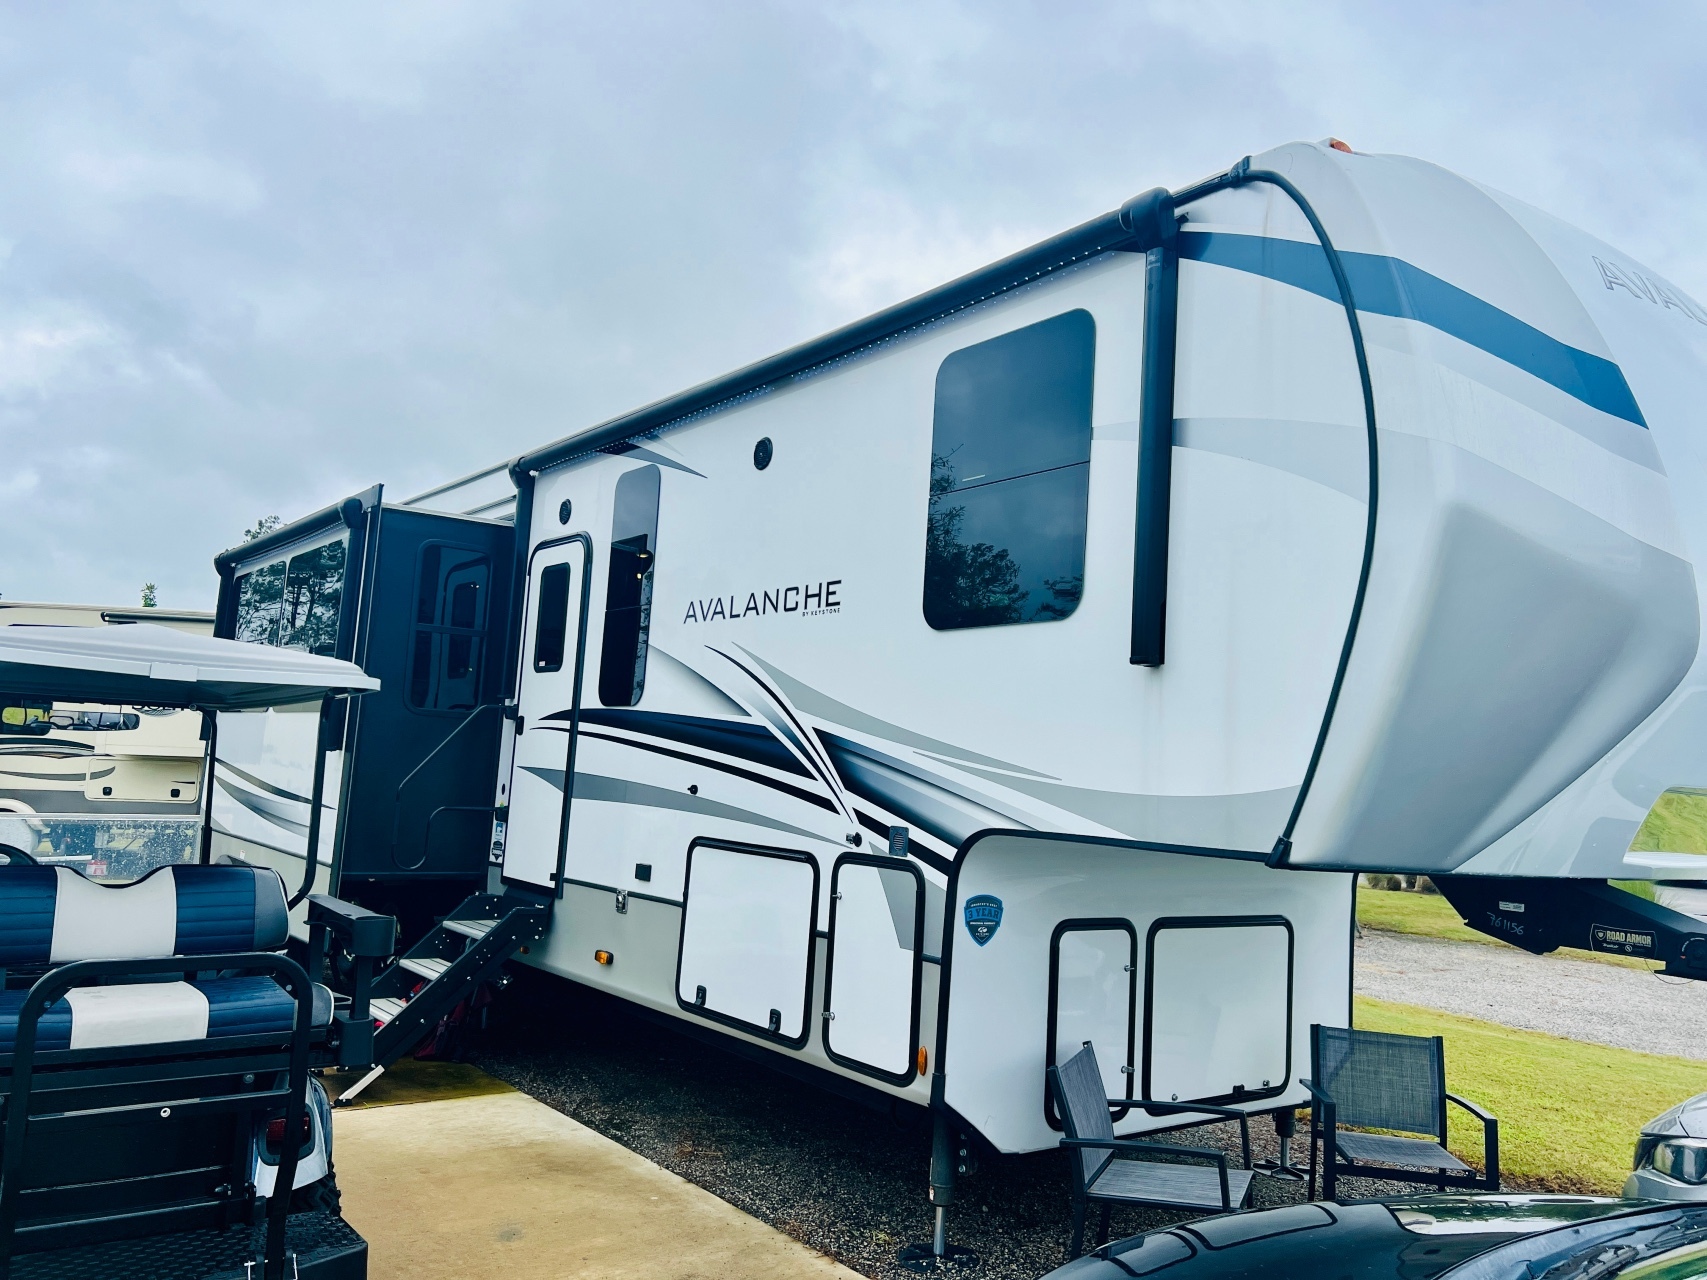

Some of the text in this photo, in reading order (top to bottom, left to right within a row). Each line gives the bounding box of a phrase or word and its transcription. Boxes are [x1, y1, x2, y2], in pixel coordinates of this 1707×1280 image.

[683, 579, 842, 625] AVALANCHE
[802, 607, 841, 618] BY KEYSTONE
[967, 907, 1000, 920] 3 YEAR
[1486, 911, 1525, 936] 761156
[1606, 930, 1626, 942] ROAD
[1626, 933, 1652, 946] ARMOR
